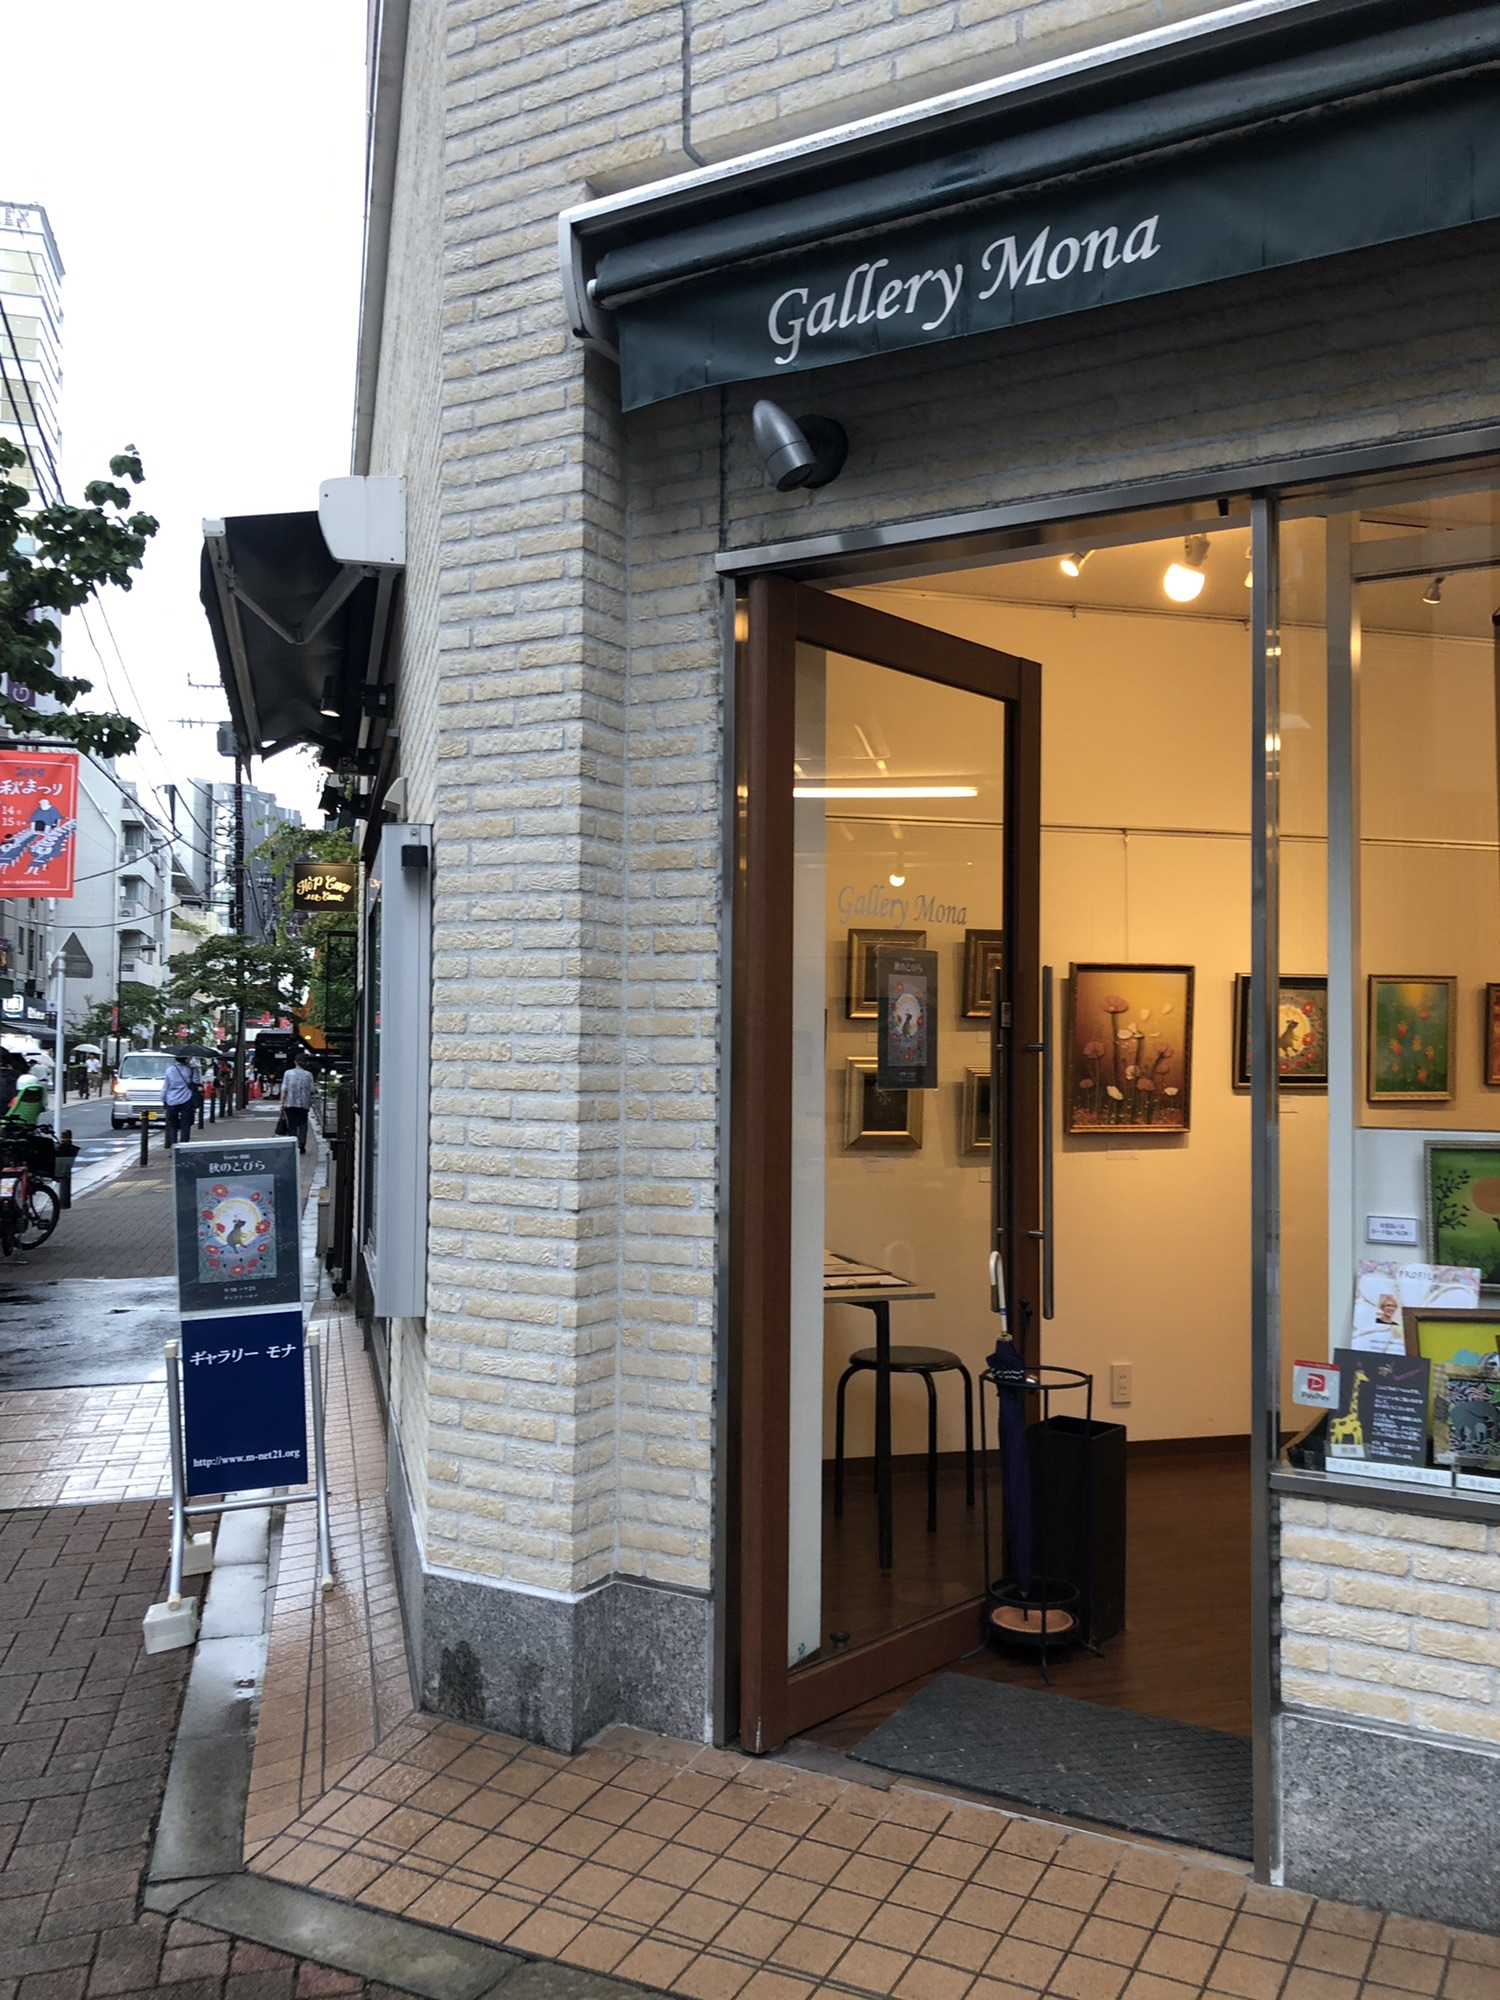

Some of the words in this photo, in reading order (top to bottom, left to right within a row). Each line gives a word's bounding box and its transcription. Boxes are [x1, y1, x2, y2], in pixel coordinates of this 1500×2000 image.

[767, 257, 964, 366] Gallery
[977, 214, 1162, 301] Mona
[0, 778, 63, 796] 秋まつり
[837, 884, 910, 929] Gallery
[912, 894, 968, 926] Mona
[208, 1160, 266, 1174] 秋のとびら
[189, 1347, 260, 1366] ギャラリー
[265, 1343, 297, 1359] モナ
[1301, 1391, 1330, 1402] PayPay
